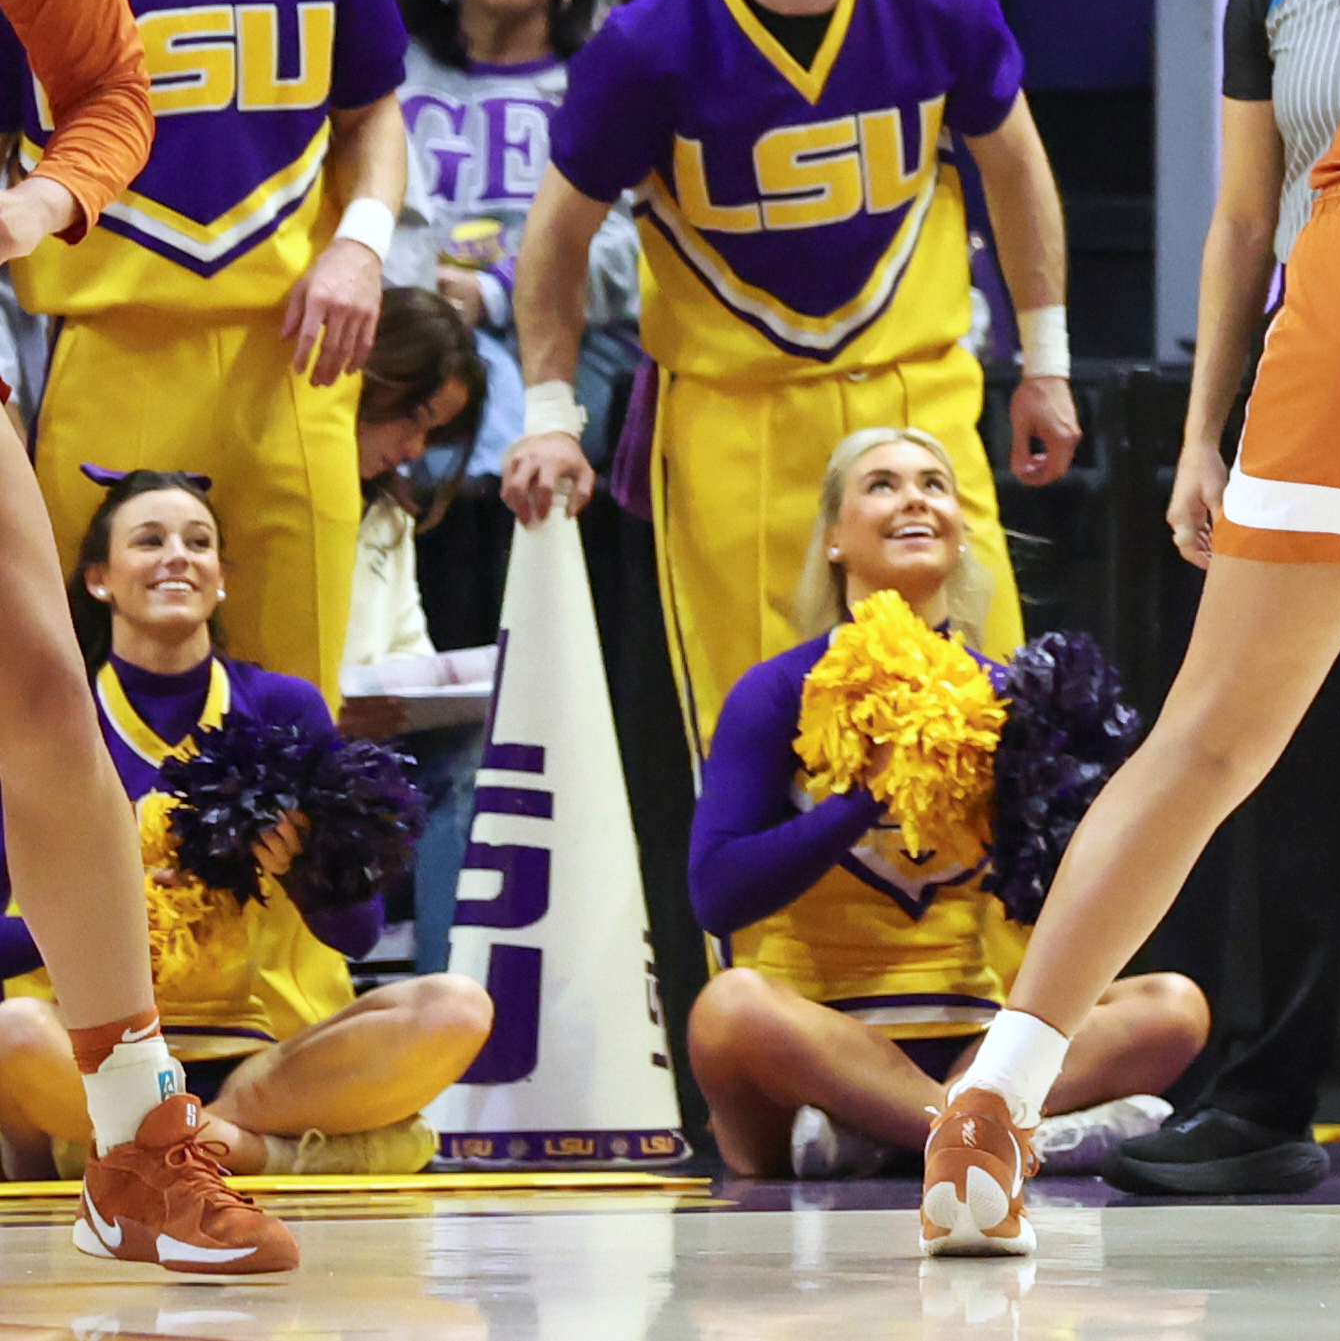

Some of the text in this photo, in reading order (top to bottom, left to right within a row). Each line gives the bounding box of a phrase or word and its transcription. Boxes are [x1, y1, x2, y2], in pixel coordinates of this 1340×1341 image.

[32, 0, 335, 132] SU
[674, 93, 946, 233] LSU
[544, 1136, 595, 1156] LSU
[639, 1134, 676, 1155] LSU
